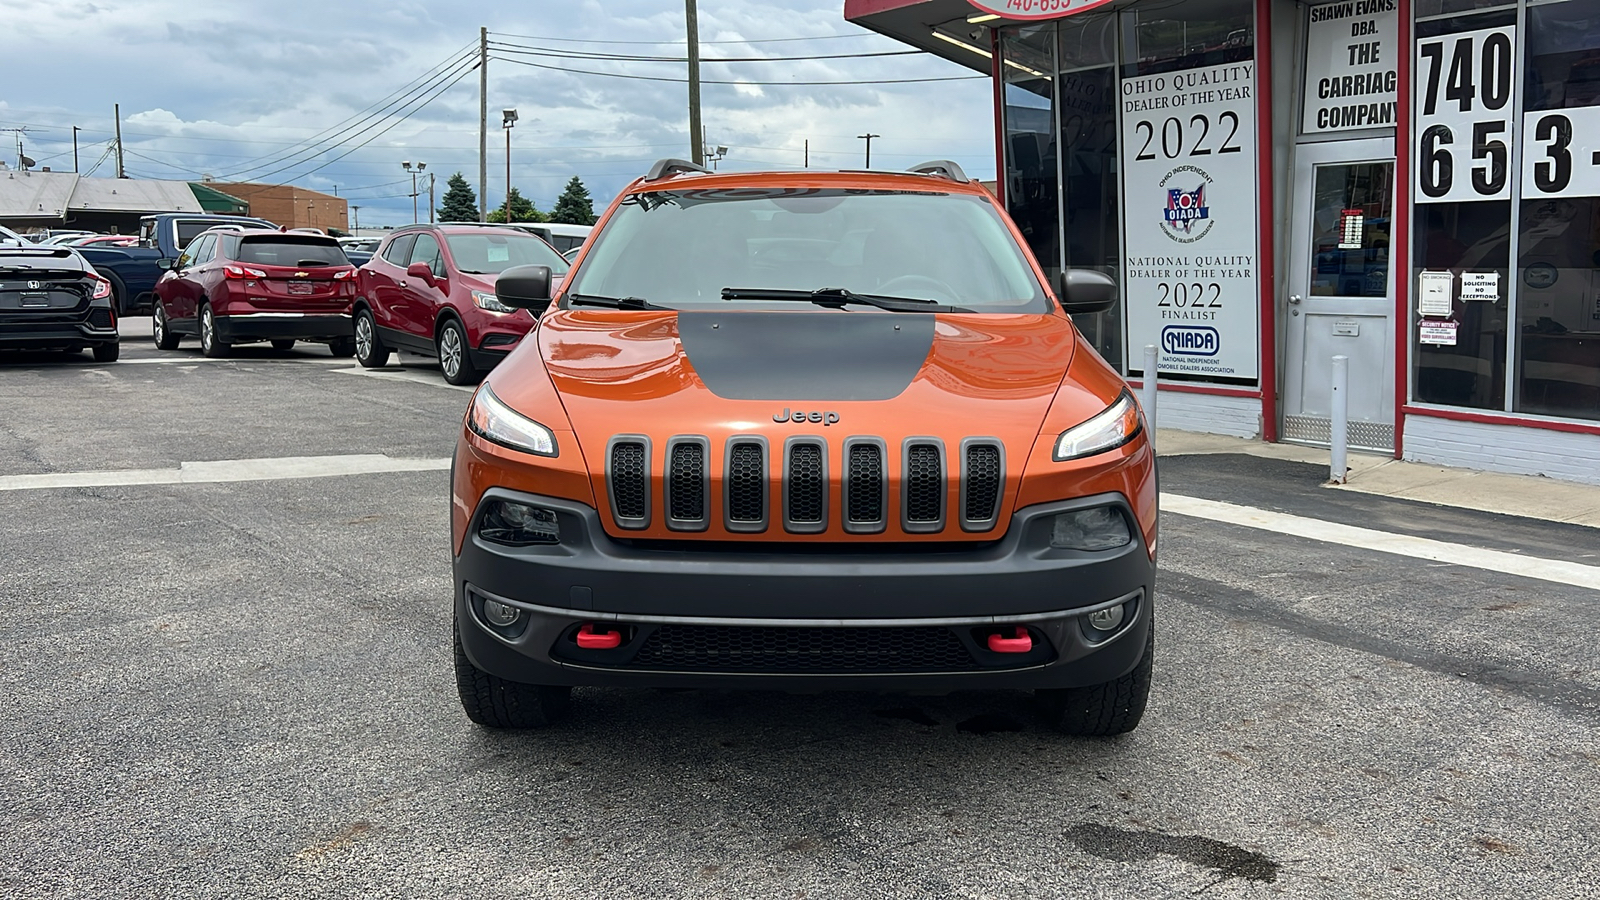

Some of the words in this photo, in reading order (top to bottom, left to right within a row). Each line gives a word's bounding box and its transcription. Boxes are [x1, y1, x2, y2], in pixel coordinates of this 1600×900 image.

[1311, 2, 1353, 22] SHAWN
[1351, 20, 1379, 37] DBA.
[1347, 41, 1380, 66] THE
[1123, 77, 1165, 96] OHIO
[1173, 64, 1252, 91] QUALITY
[1421, 32, 1511, 115] 740
[1318, 70, 1397, 99] CARRIAG
[1125, 96, 1169, 113] DEALER
[1171, 93, 1187, 107] OF
[1190, 90, 1214, 105] THE
[1217, 85, 1251, 102] YEAR
[1135, 110, 1241, 161] 2022
[1159, 171, 1173, 187] OHIO
[1172, 165, 1214, 184] INDEPENDENT
[1169, 208, 1202, 220] OIADA
[1128, 257, 1190, 266] NATIONAL
[1195, 256, 1253, 267] QUALITY
[1130, 269, 1171, 278] DEALER
[1175, 269, 1189, 278] OF
[1194, 269, 1216, 278] THE
[1221, 269, 1251, 278] YEAR
[1157, 282, 1222, 308] 2022
[1162, 310, 1216, 320] FINALIST
[1166, 332, 1214, 350] NIADA
[1201, 366, 1235, 374] ASSOCIATION
[772, 407, 840, 426] Jeep
